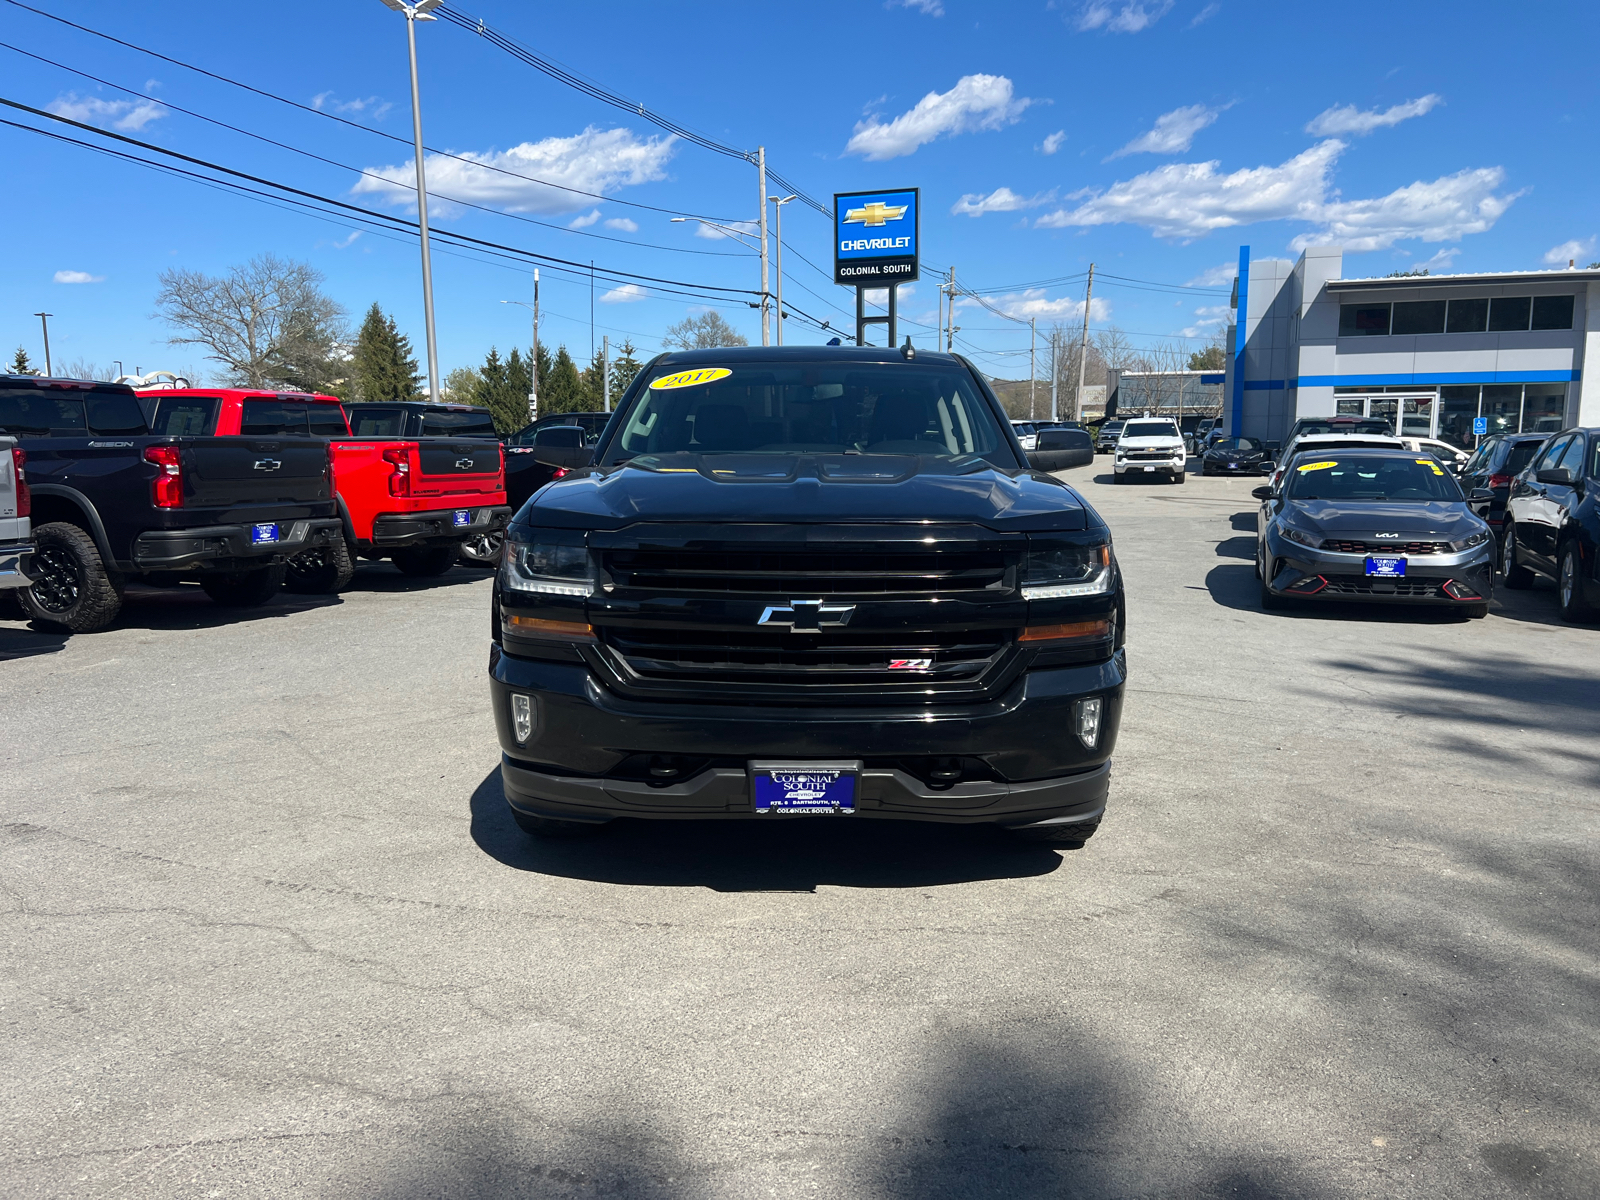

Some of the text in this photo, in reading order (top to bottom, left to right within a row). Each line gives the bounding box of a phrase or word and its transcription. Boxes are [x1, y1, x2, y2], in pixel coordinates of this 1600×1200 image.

[841, 236, 911, 251] CHEVROLET
[840, 264, 911, 276] COLONIAL SOUTH
[663, 370, 717, 388] 2017
[889, 658, 932, 669] Z71
[774, 774, 836, 783] COLONIAL
[783, 782, 827, 791] SOUTH
